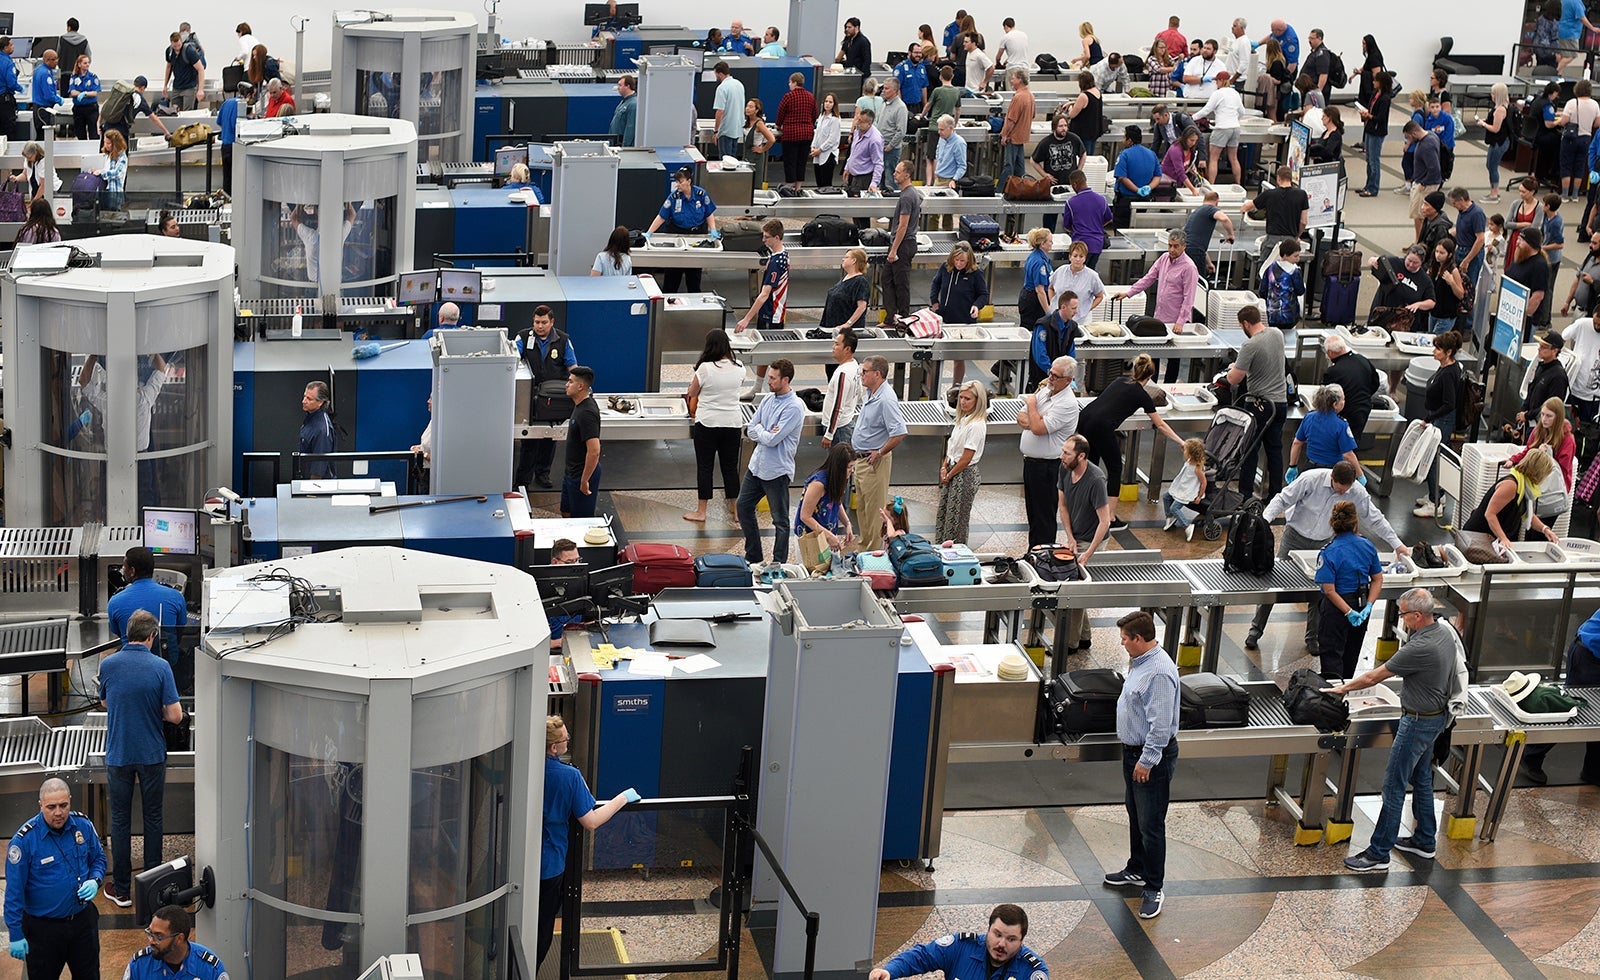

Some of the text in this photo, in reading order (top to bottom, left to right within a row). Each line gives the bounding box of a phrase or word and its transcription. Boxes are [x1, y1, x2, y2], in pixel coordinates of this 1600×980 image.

[771, 271, 777, 283] 1
[1501, 300, 1516, 315] HOLD
[1566, 542, 1591, 551] FLEXISPOT
[617, 698, 649, 706] smiths
